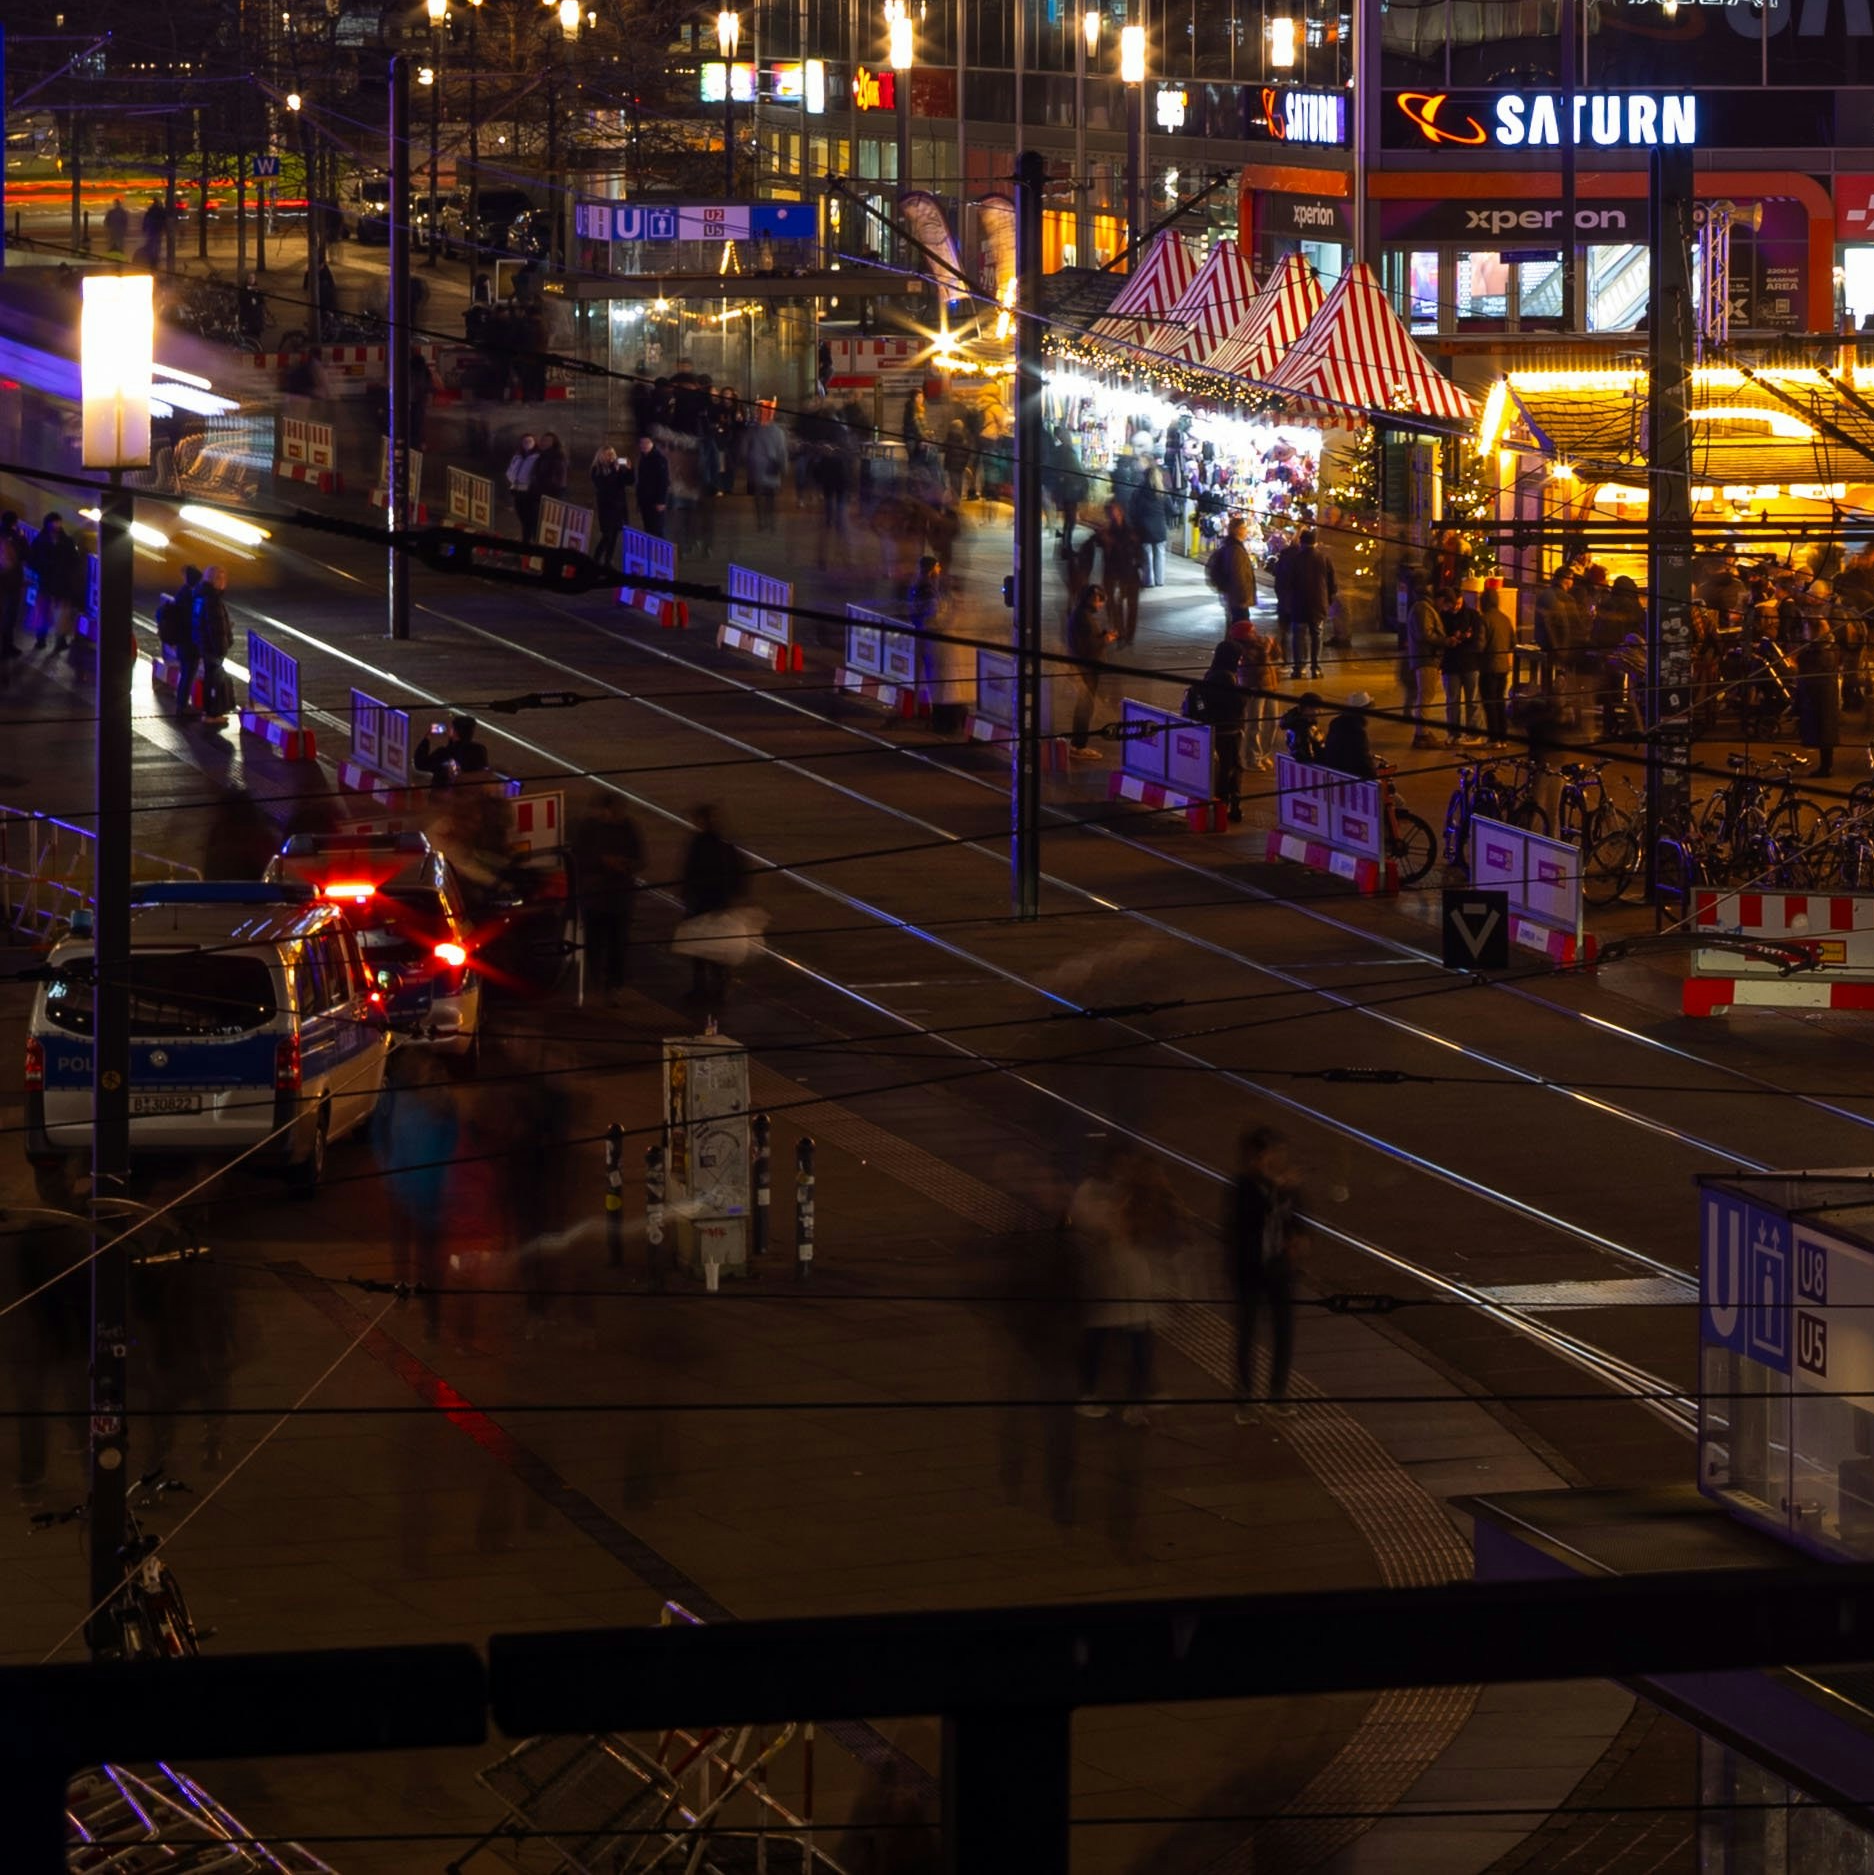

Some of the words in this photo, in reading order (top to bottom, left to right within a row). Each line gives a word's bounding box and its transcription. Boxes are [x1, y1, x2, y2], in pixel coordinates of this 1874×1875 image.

[1285, 91, 1338, 144] SATURN
[1495, 95, 1697, 146] SATURN
[257, 158, 275, 175] W
[616, 208, 642, 239] U
[705, 210, 724, 221] U2
[1293, 202, 1334, 228] xperion
[1466, 209, 1627, 235] xperon
[705, 226, 724, 237] U5
[1766, 283, 1799, 291] AREA
[1707, 1201, 1740, 1337] U
[1800, 1245, 1824, 1297] U8
[1800, 1314, 1824, 1369] U5
